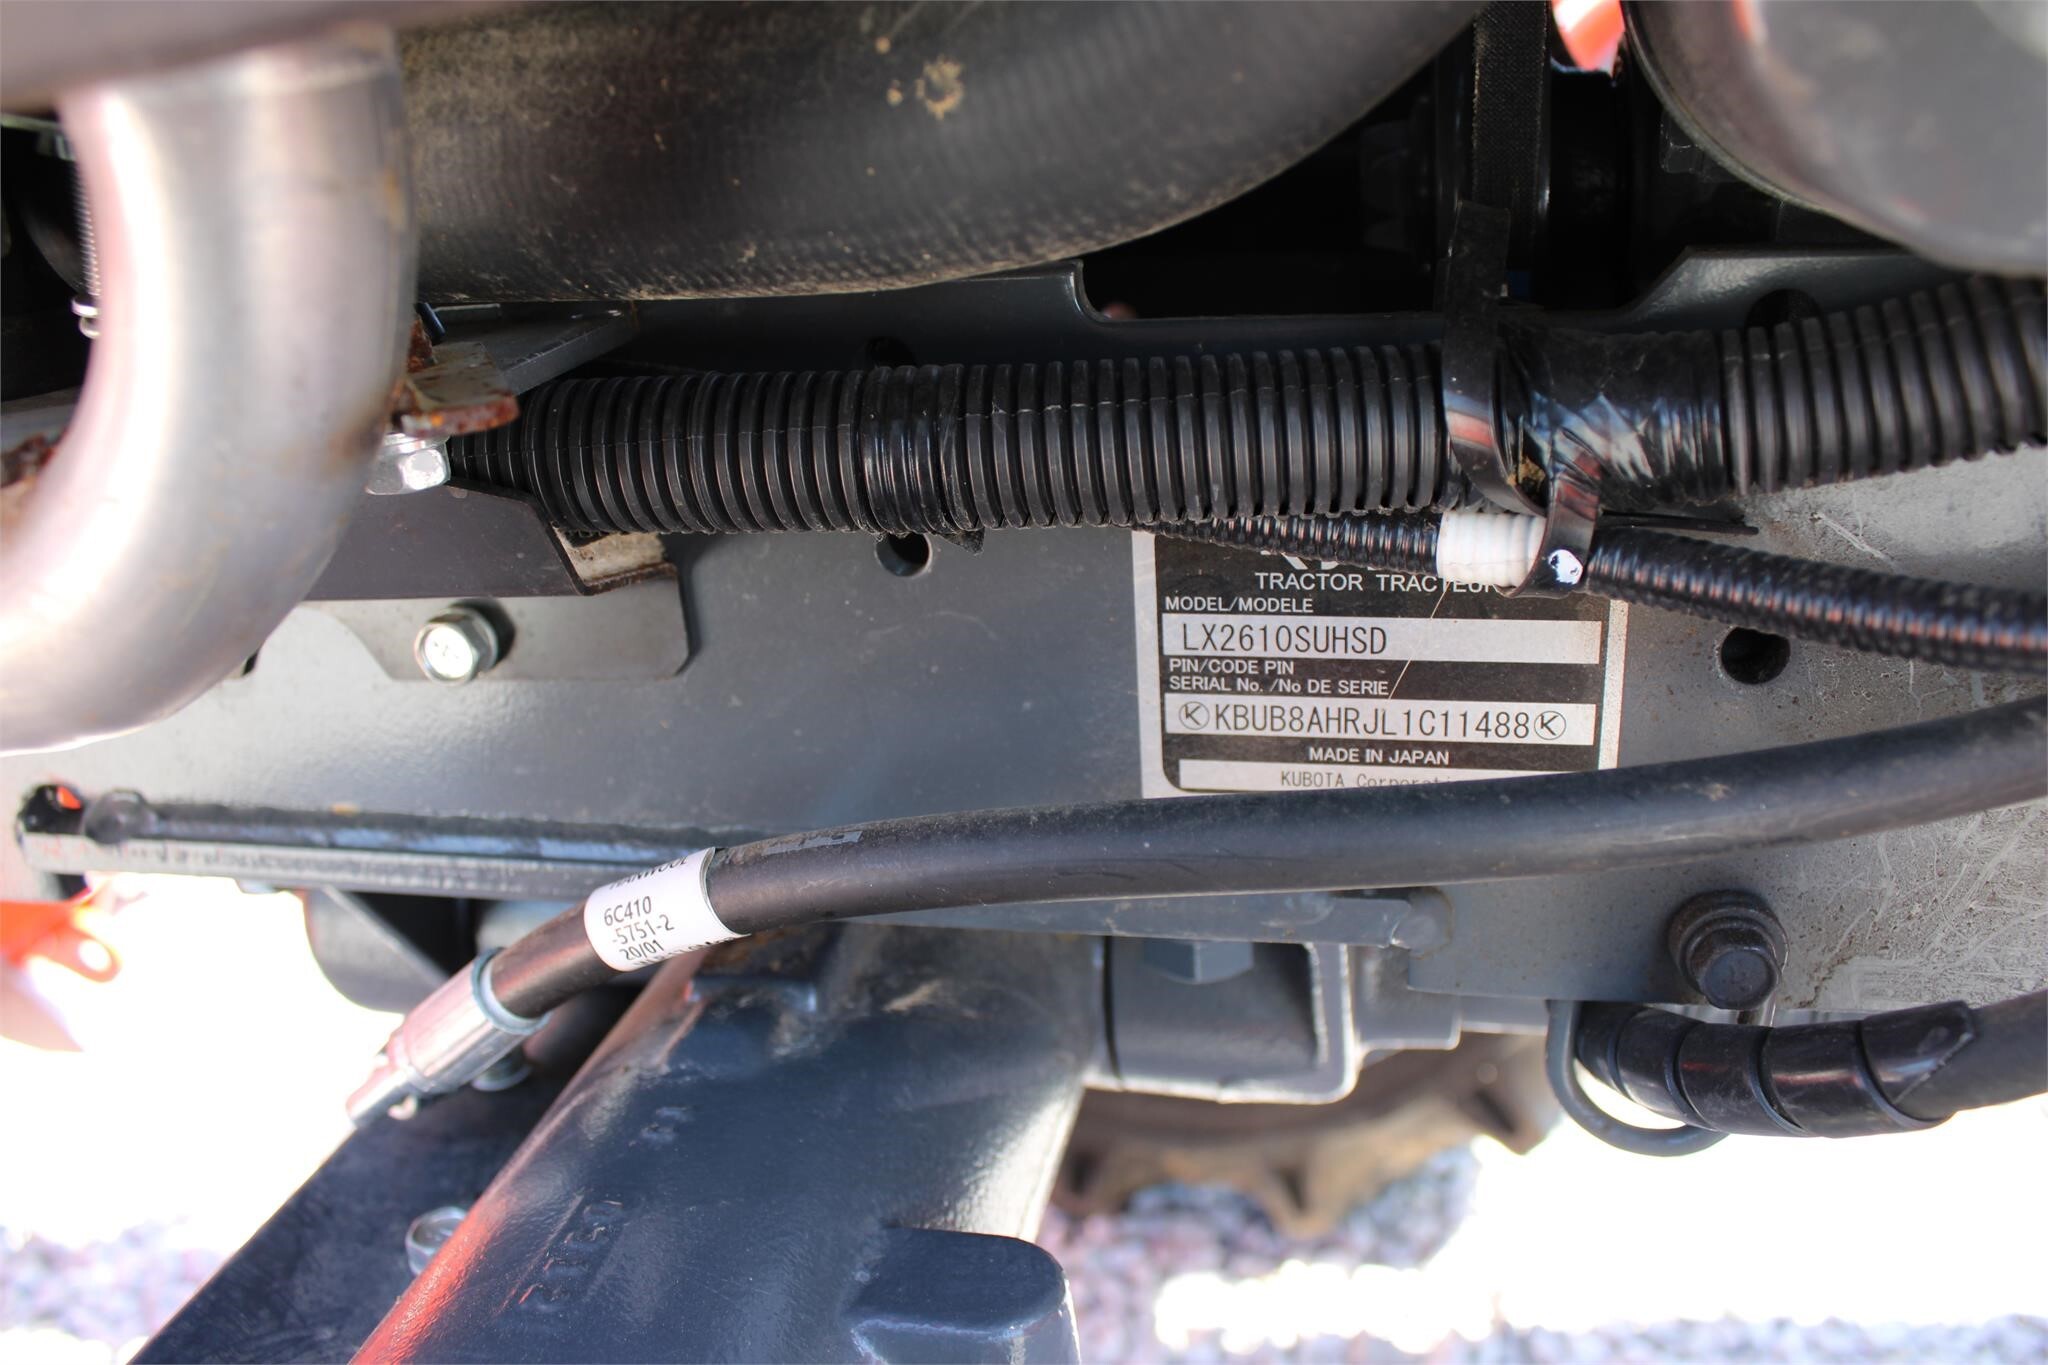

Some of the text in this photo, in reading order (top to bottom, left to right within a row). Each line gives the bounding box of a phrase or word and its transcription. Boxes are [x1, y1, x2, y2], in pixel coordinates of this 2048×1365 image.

[1255, 572, 1363, 591] TRACTOR
[1165, 596, 1314, 613] MODEL/MODELE
[1183, 623, 1387, 654] LX2610SUHSD
[1169, 658, 1294, 675] PIN/CODE PIN
[1169, 676, 1231, 691] SERIAL
[1236, 678, 1263, 693] No.
[1308, 679, 1331, 694] DE
[1338, 680, 1389, 695] SERIE
[1309, 747, 1450, 765] MADE IN JAPAN
[1281, 771, 1345, 787] KUBOTA
[604, 895, 652, 926] 6C410
[612, 914, 674, 945] -5751-2
[619, 940, 664, 961] 20/01
